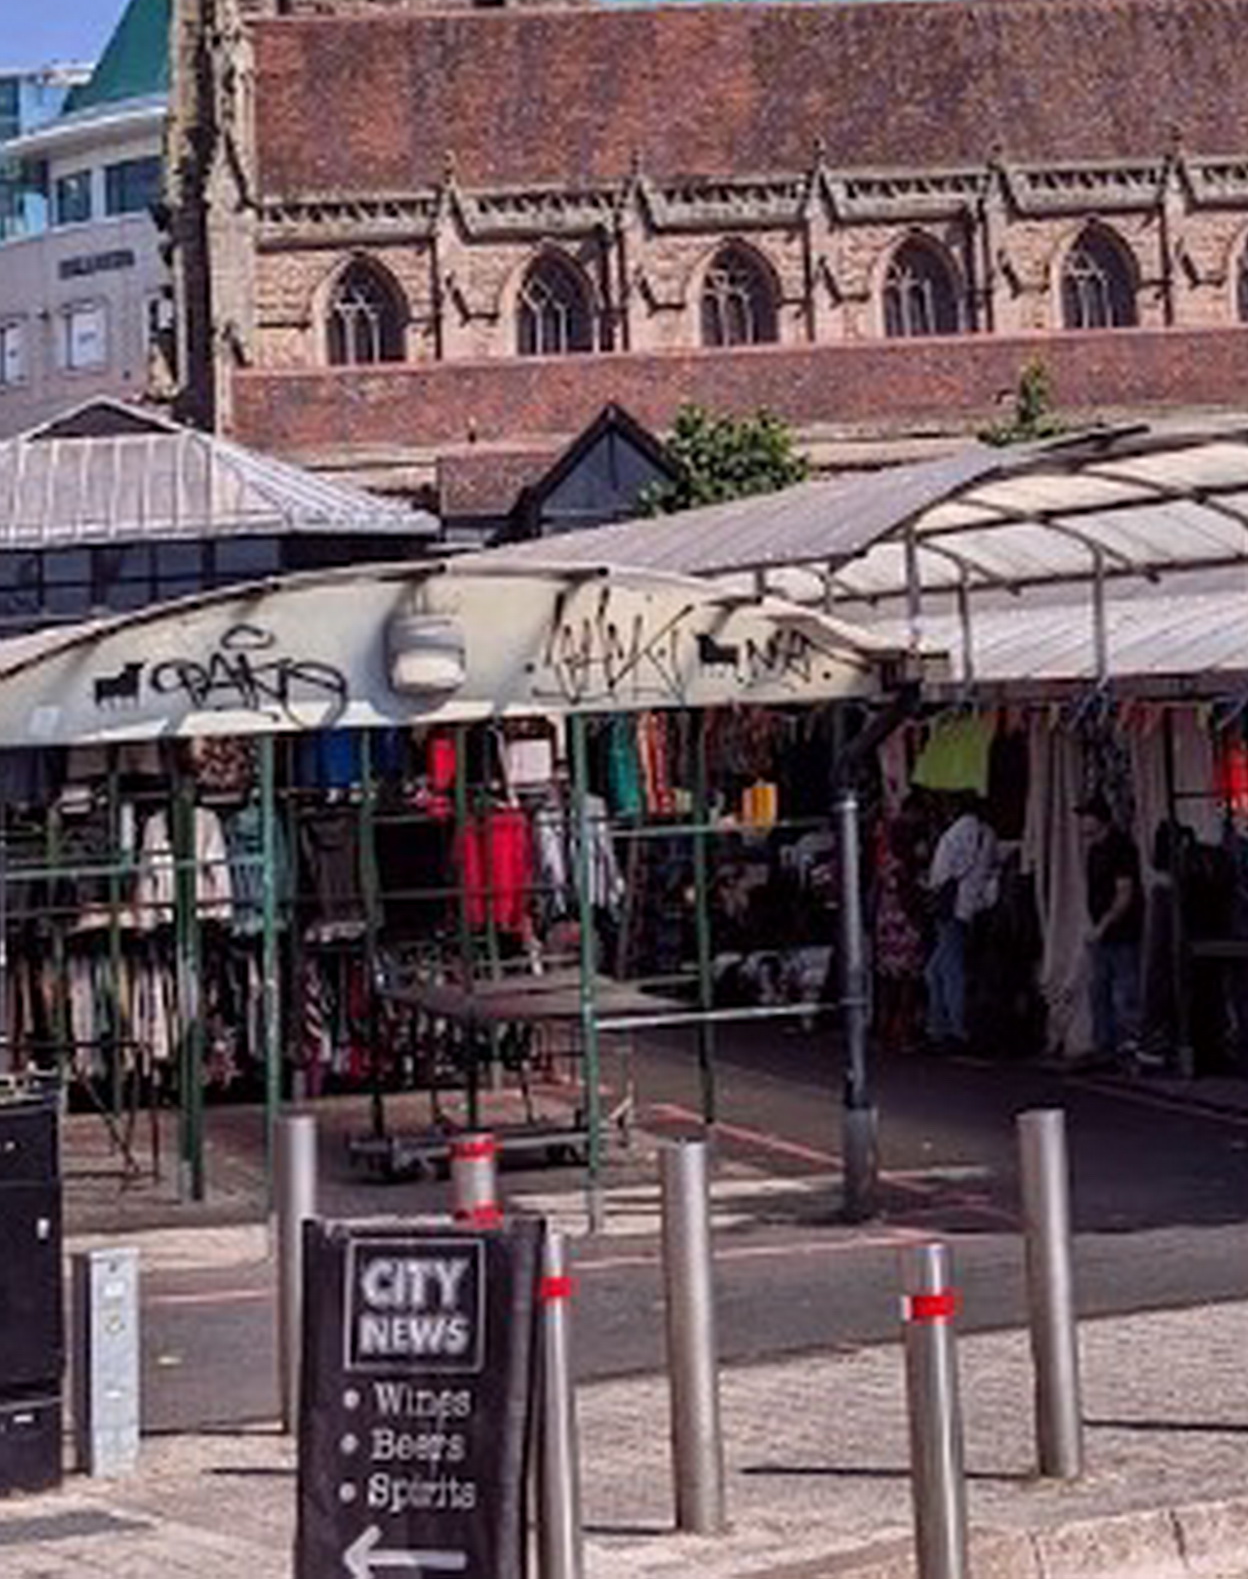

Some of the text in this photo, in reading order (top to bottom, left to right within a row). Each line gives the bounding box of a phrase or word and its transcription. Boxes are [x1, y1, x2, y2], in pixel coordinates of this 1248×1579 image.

[361, 1258, 470, 1308] CITY
[359, 1316, 470, 1356] NEWS
[373, 1382, 471, 1417] Wines
[371, 1428, 466, 1460] Beers
[368, 1472, 477, 1513] Spirits
